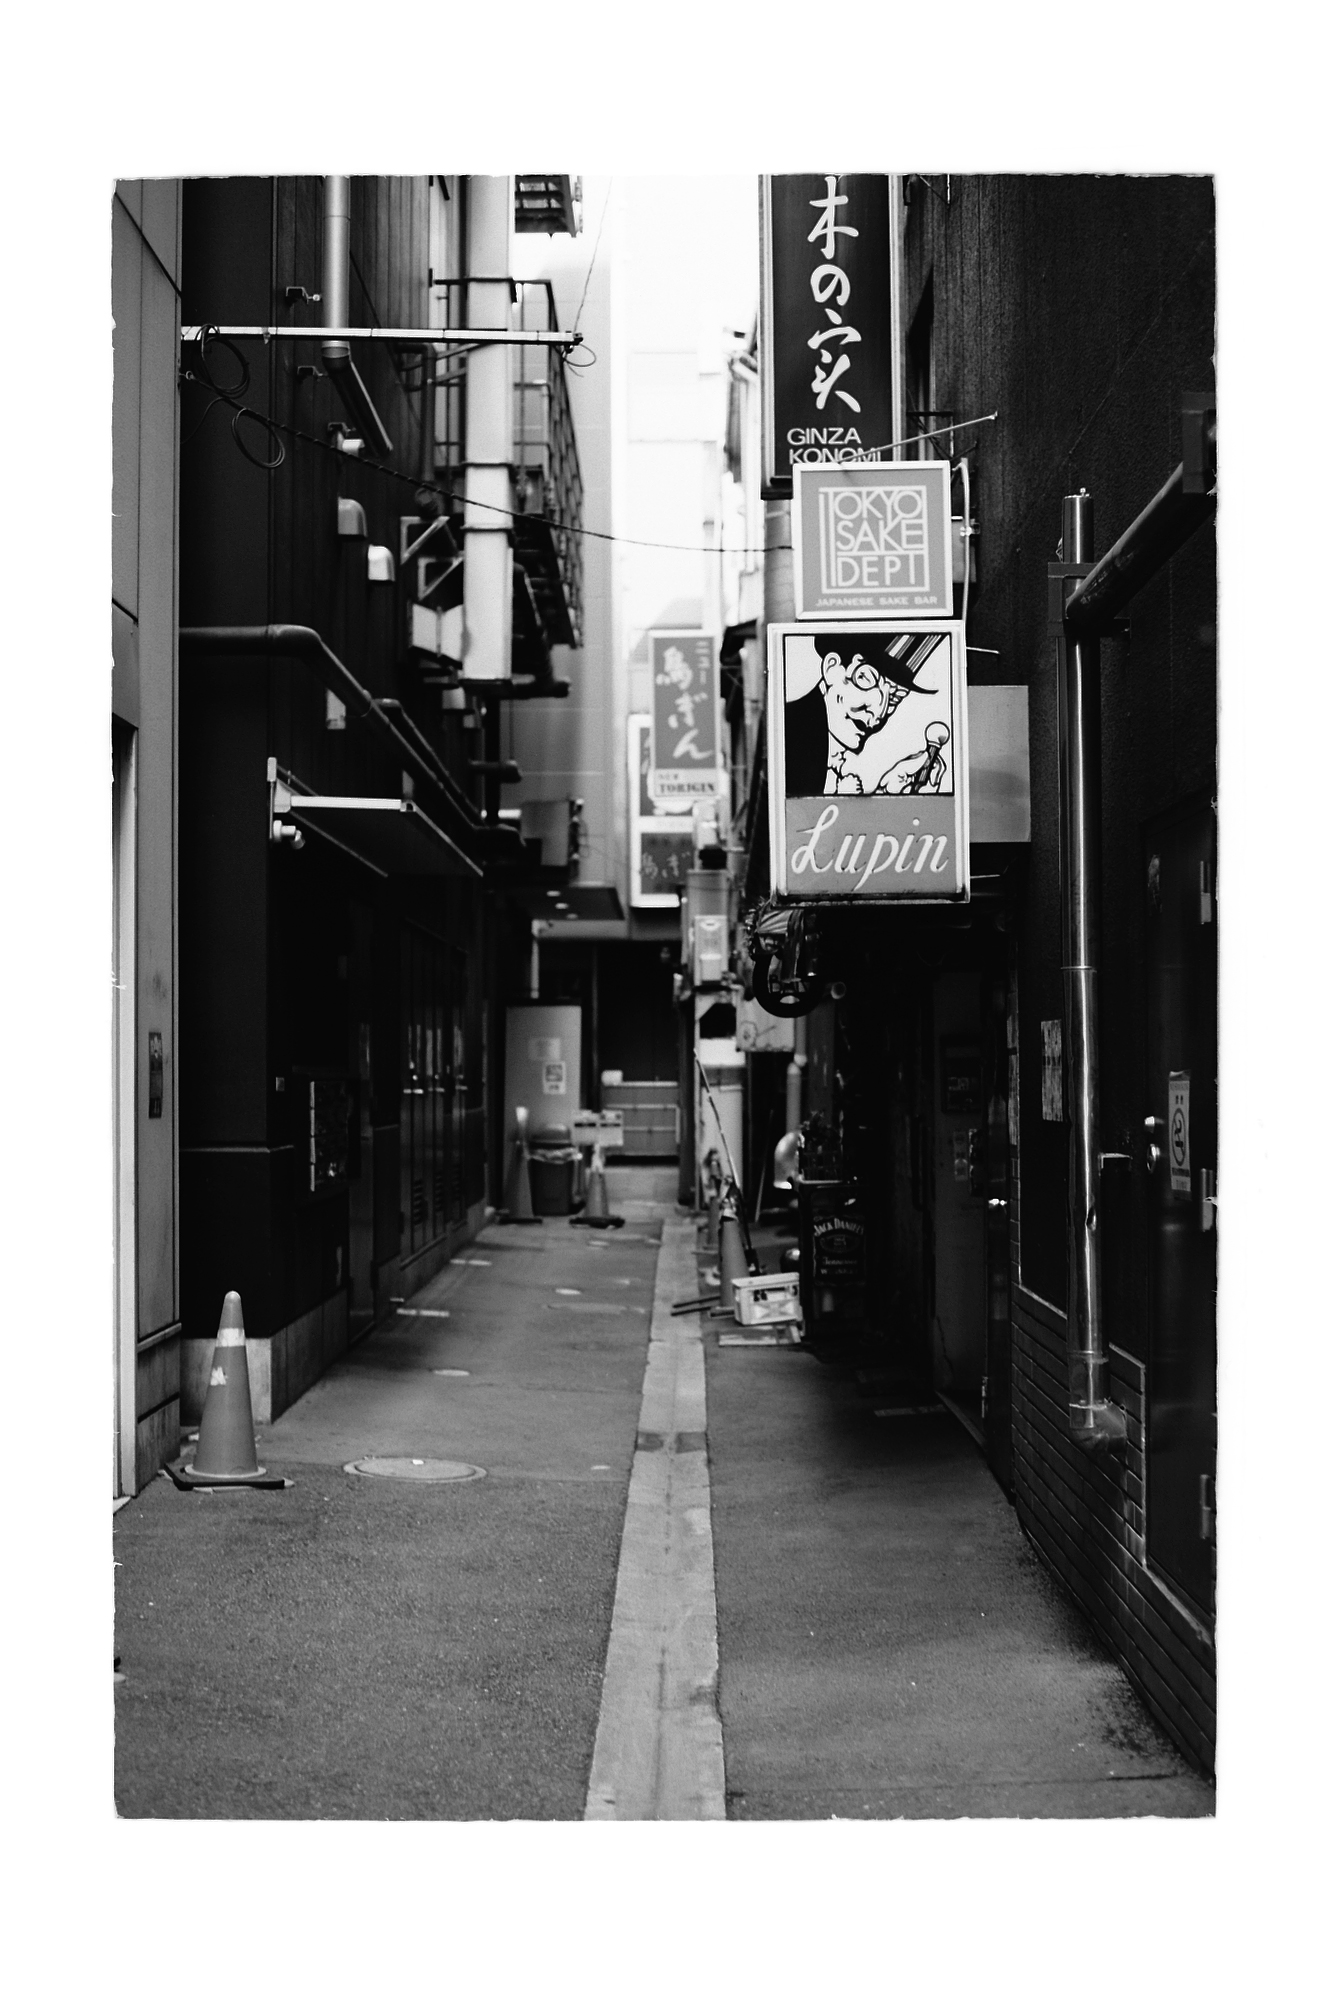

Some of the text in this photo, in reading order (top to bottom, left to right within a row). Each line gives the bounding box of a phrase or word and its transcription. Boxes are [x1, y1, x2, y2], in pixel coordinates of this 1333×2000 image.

[807, 175, 862, 413] 木の実
[786, 427, 862, 446] GINZA
[788, 447, 882, 465] KONOMI
[819, 485, 926, 524] TOKYO
[836, 519, 925, 553] SAKE
[836, 552, 925, 587] DEPT
[815, 595, 938, 607] JAPANESE SAKE BAR
[660, 782, 715, 793] TORIGIN
[790, 803, 949, 892] Lupin
[813, 1221, 834, 1237] JACK
